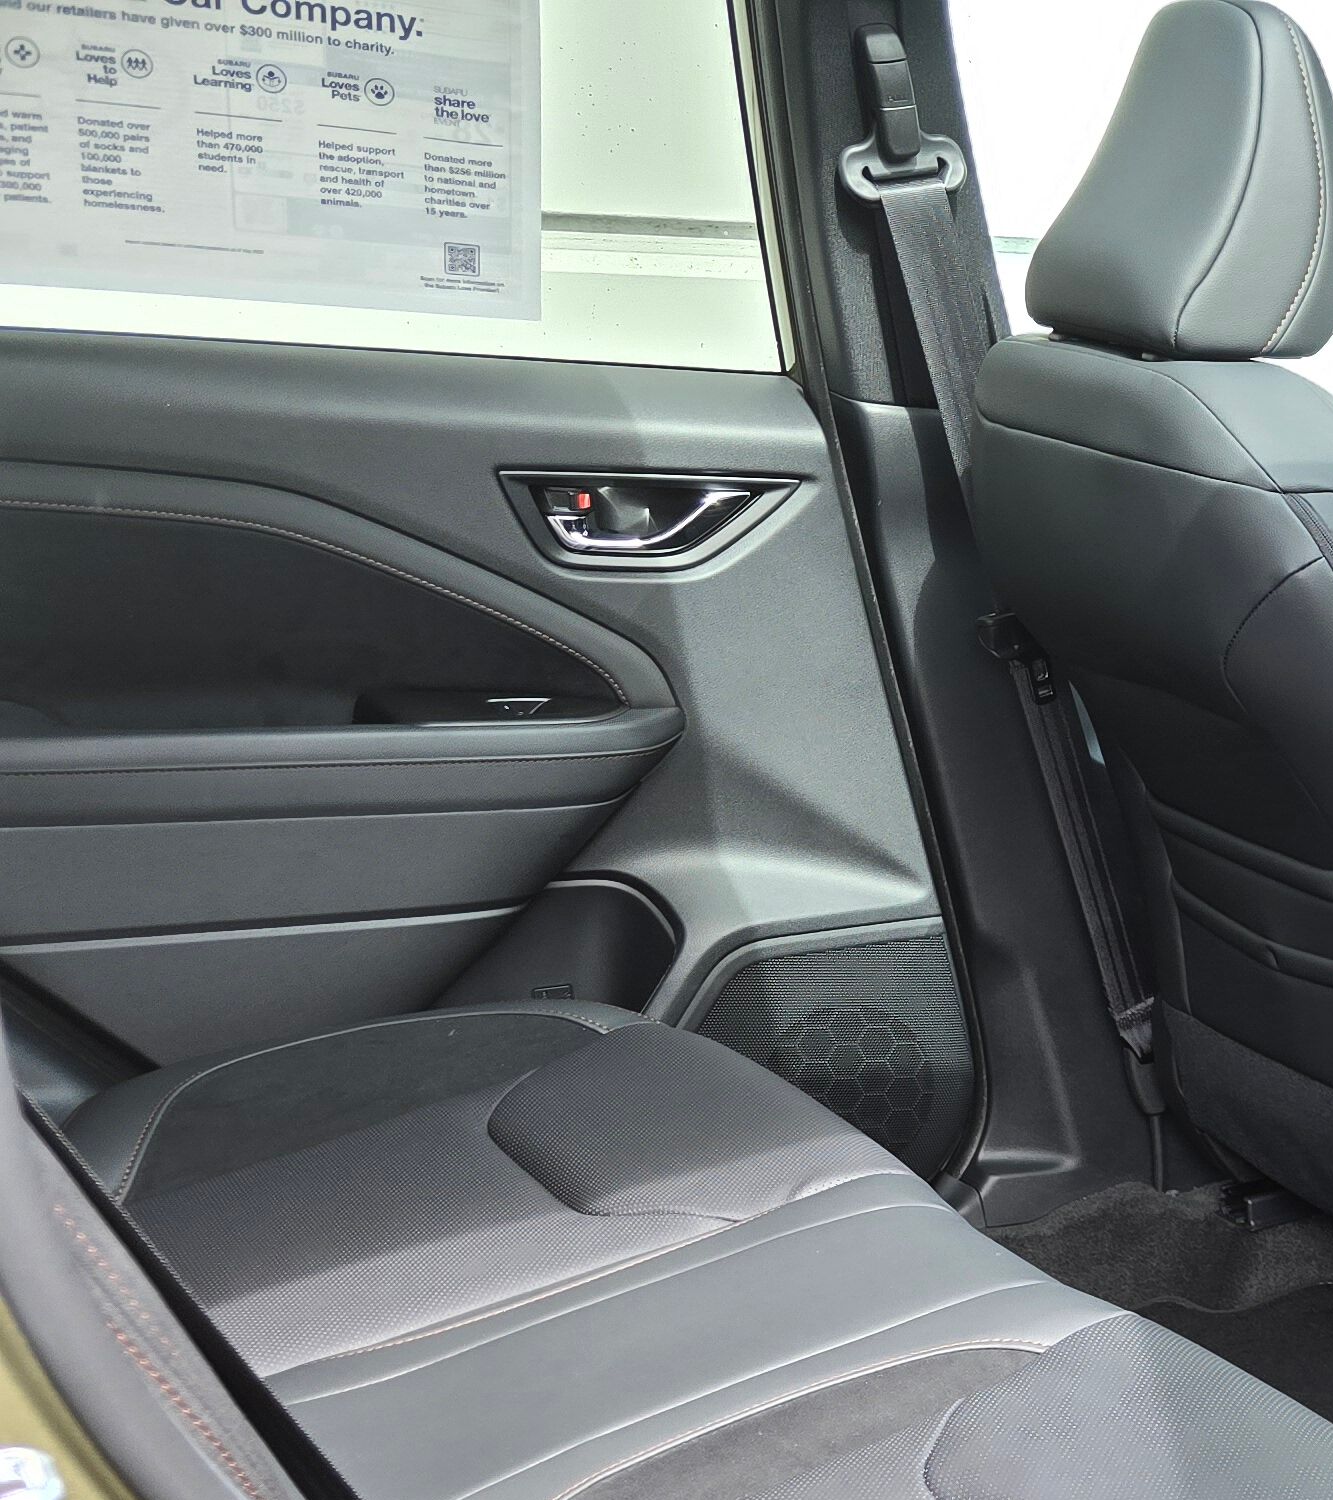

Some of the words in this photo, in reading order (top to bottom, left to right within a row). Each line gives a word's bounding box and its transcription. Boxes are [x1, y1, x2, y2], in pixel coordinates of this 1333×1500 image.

[26, 2, 51, 12] our
[56, 4, 117, 20] retailers
[121, 10, 157, 25] have
[160, 16, 201, 29] given
[204, 21, 236, 34] over
[239, 24, 273, 39] $300
[276, 29, 323, 45] million
[327, 35, 341, 47] to
[344, 39, 395, 56] charity.
[75, 50, 117, 65] Loves
[217, 58, 251, 68] SUBARU
[102, 64, 118, 75] to
[211, 65, 252, 80] Loves
[326, 71, 360, 81] SUBARU
[86, 73, 118, 88] Help
[193, 74, 252, 93] Learning
[321, 77, 360, 92] Loves
[331, 89, 361, 103] Pets
[433, 95, 476, 110] share
[434, 106, 459, 120] the
[460, 109, 490, 123] love
[77, 116, 123, 129] Donated
[126, 122, 151, 131] over
[78, 128, 121, 141] 500,000
[123, 132, 150, 143] pairs
[196, 128, 233, 141] Helped
[236, 133, 263, 142] more
[79, 140, 91, 149] of
[93, 142, 126, 153] socks
[128, 145, 149, 154] and
[196, 140, 220, 149] than
[223, 142, 263, 154] 470,000
[318, 139, 354, 152] Helped
[356, 145, 396, 157] support
[81, 151, 122, 164] 100,000
[197, 152, 243, 163] students
[246, 155, 256, 164] in
[319, 152, 335, 161] the
[337, 154, 384, 167] adoption,
[424, 152, 465, 164] Donated
[468, 158, 493, 167] more
[81, 163, 128, 176] blankets
[130, 166, 142, 177] to
[198, 163, 228, 173] need.
[319, 164, 356, 175] rescue,
[358, 167, 405, 179] transport
[424, 163, 446, 173] than
[448, 166, 472, 176] $256
[474, 169, 506, 179] million
[81, 175, 113, 186] those
[320, 175, 338, 183] and
[341, 176, 372, 187] health
[374, 180, 385, 188] of
[424, 174, 434, 183] to
[437, 177, 476, 188] national
[478, 181, 497, 189] and
[82, 188, 153, 203] experiencing
[319, 187, 342, 195] over
[345, 187, 383, 198] 420,000
[83, 198, 166, 213] homelessness.
[320, 198, 362, 208] animals.
[424, 196, 467, 208] charities
[469, 202, 491, 210] over
[425, 207, 436, 215] 15
